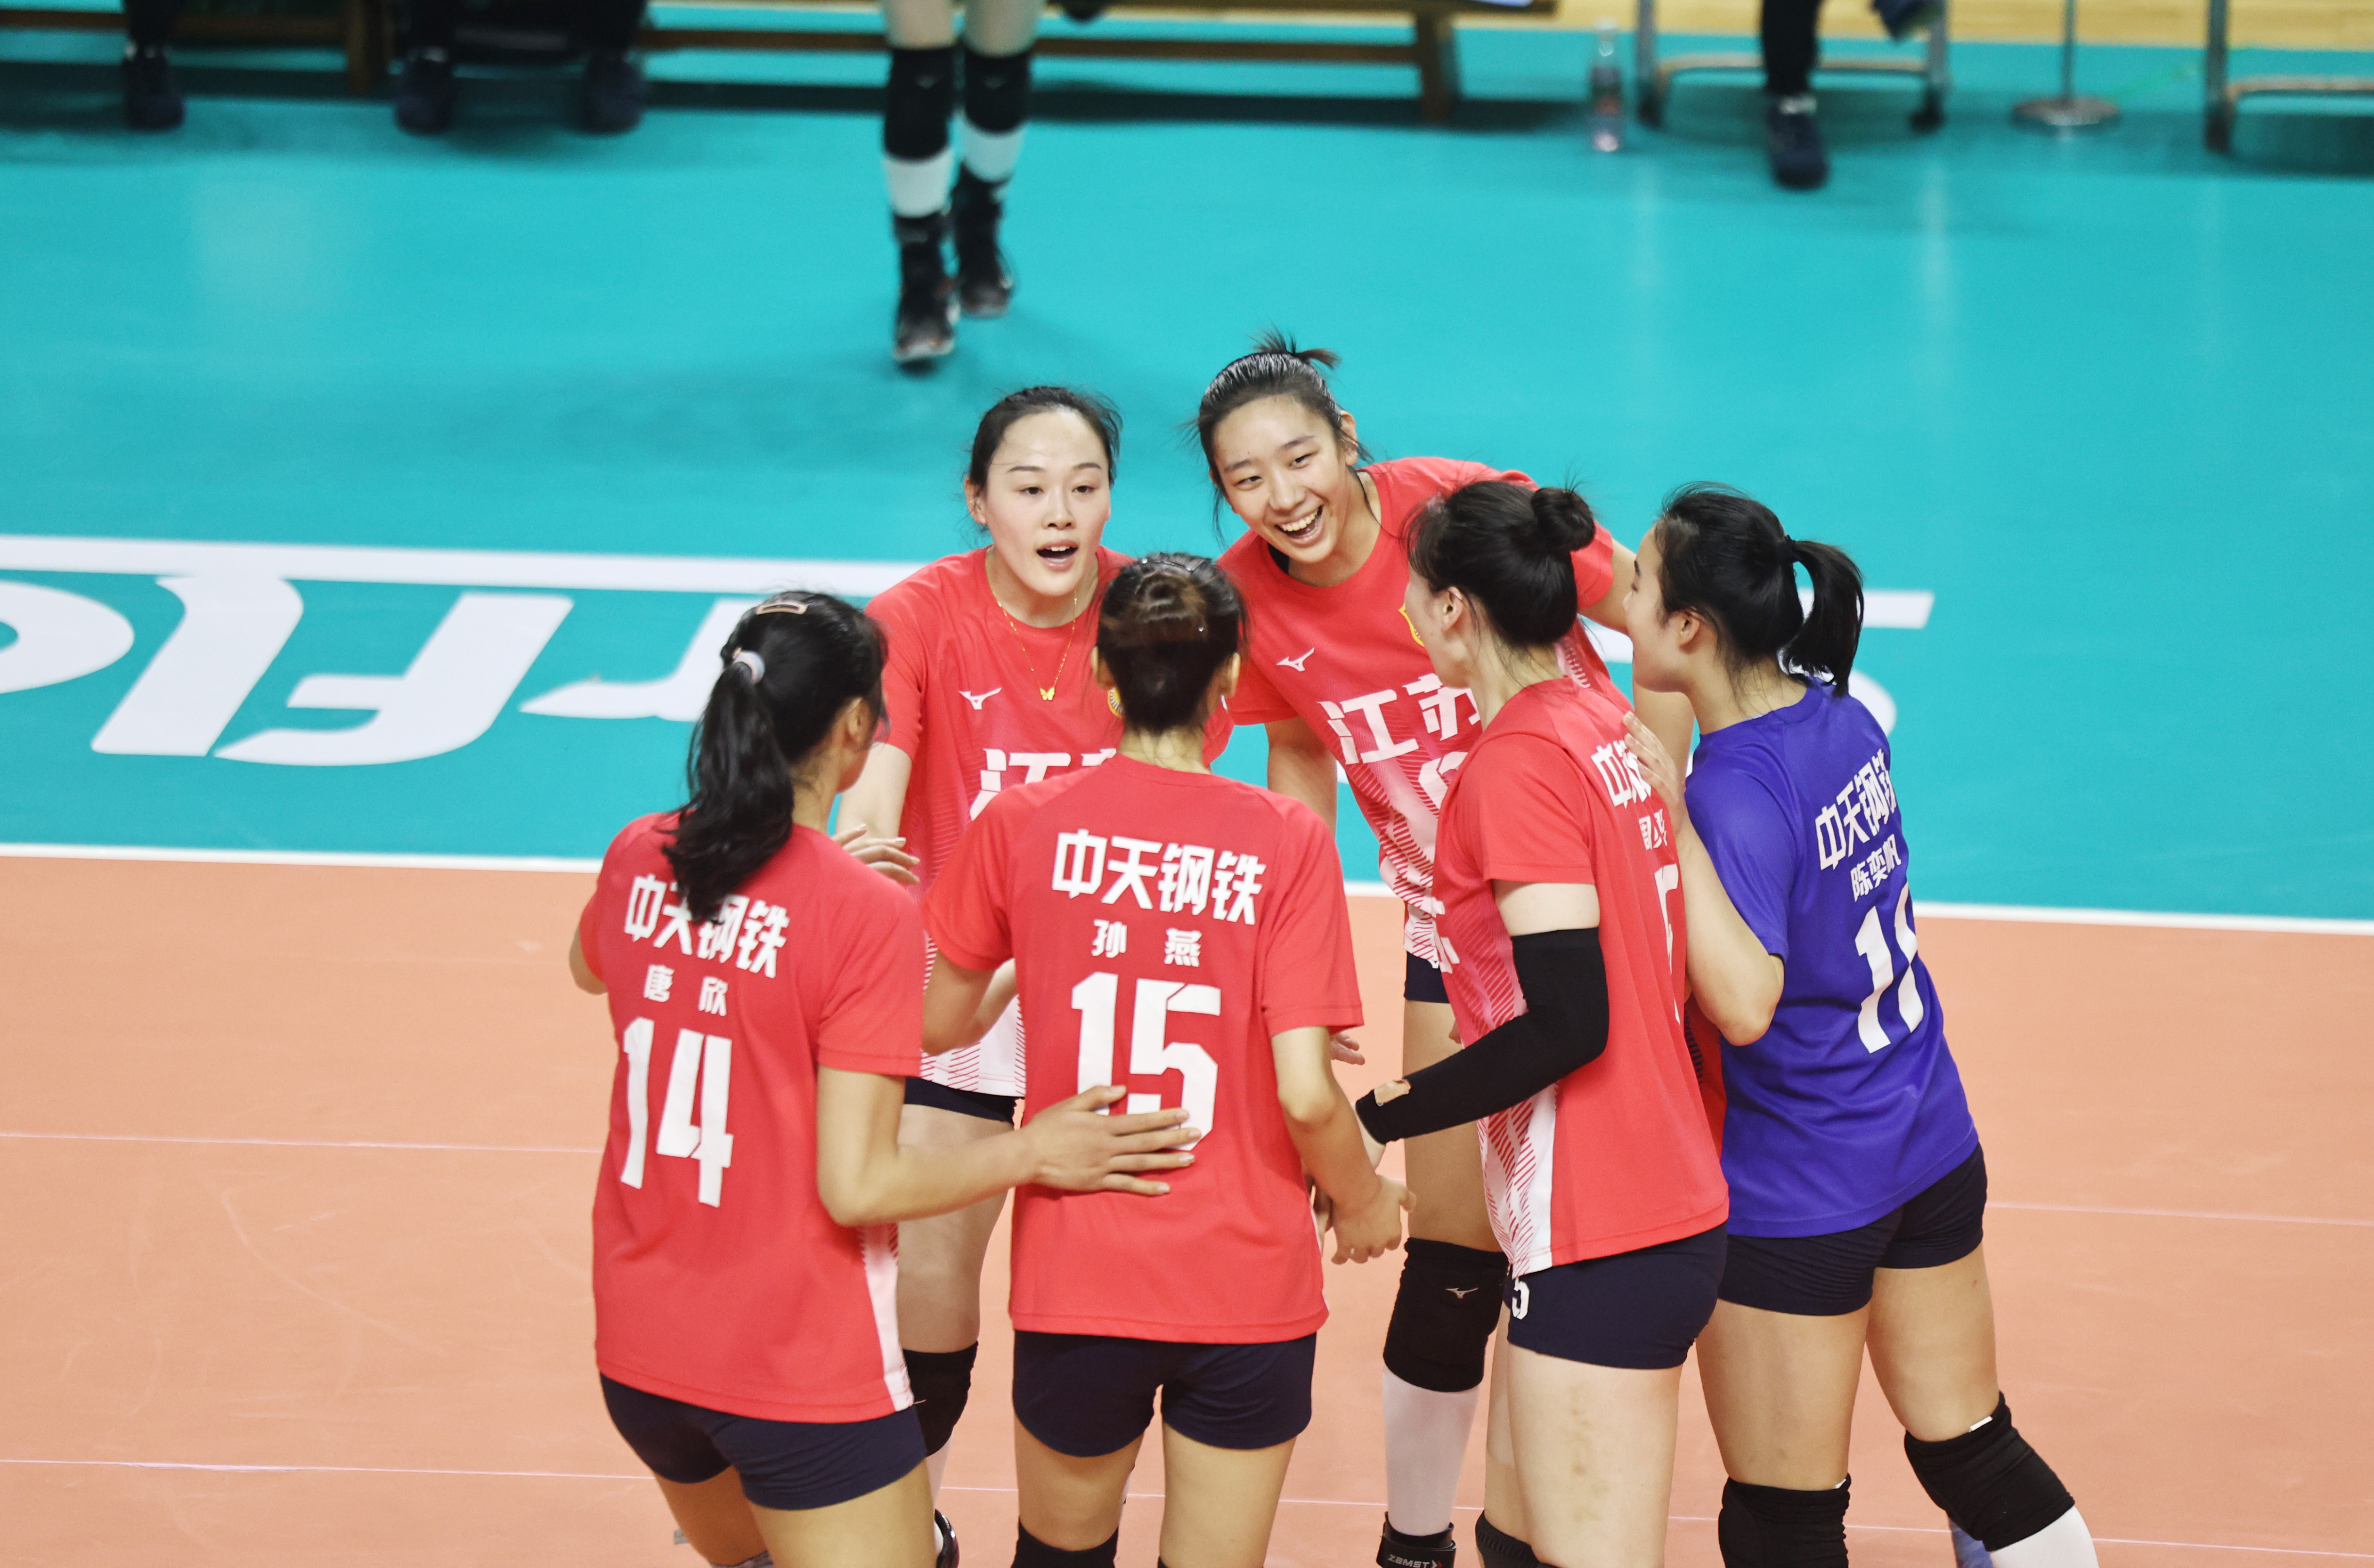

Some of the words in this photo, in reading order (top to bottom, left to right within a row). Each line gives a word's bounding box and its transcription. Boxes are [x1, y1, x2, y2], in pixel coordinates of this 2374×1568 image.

[1052, 829, 1266, 925] 中天钢铁
[1850, 833, 1902, 902] 陈奕帆
[1092, 919, 1202, 967] 孙燕
[643, 964, 729, 1016] 唐欣
[1071, 971, 1221, 1151] 15
[620, 1016, 733, 1208] 14
